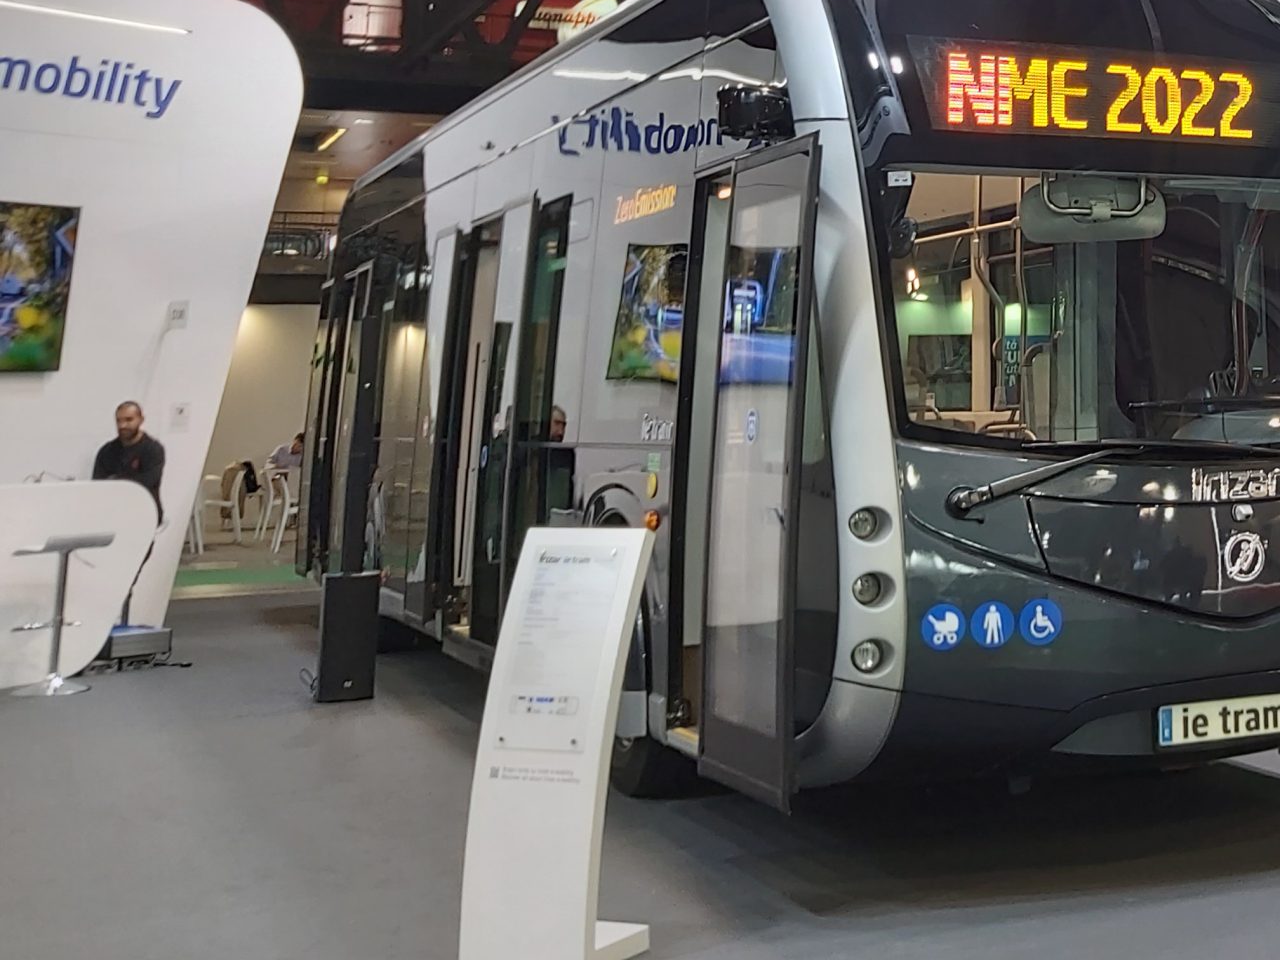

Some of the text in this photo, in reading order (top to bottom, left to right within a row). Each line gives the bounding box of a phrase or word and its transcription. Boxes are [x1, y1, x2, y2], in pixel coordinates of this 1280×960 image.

[946, 52, 1254, 139] NME 2022
[1182, 707, 1209, 739] ie
